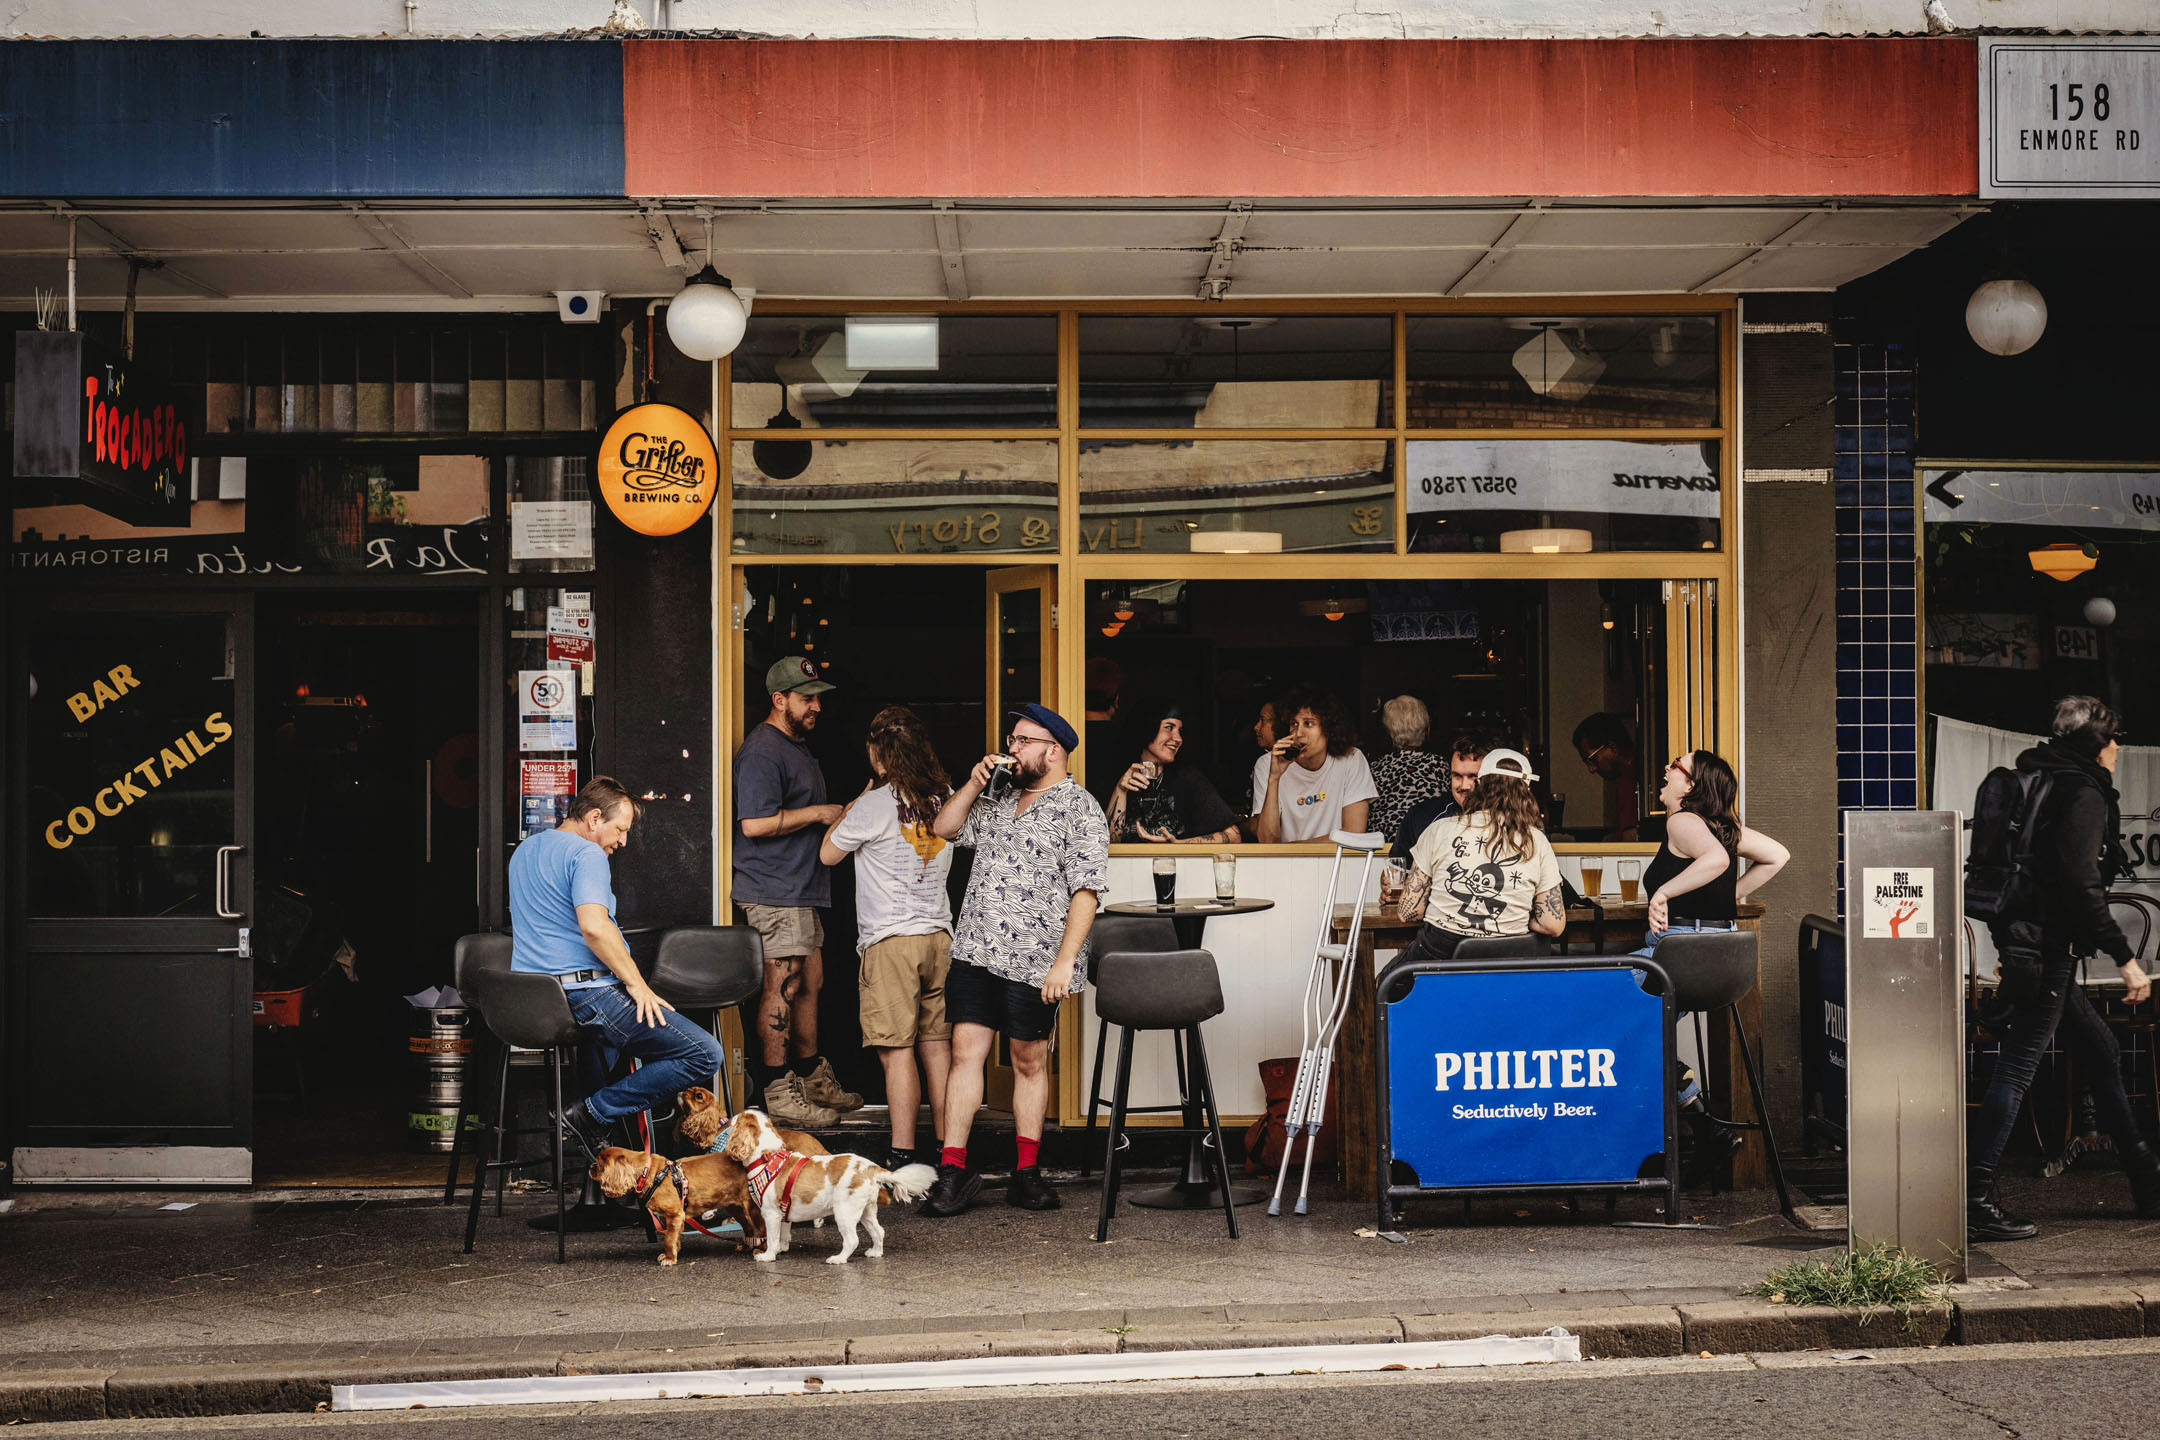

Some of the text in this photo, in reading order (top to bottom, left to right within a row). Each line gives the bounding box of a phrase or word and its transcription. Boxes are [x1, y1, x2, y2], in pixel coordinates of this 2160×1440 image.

[2049, 82, 2110, 122] 158
[2020, 128, 2140, 151] ENMORE RD
[85, 376, 186, 475] TROCADERO
[650, 435, 668, 444] THE
[619, 432, 705, 486] Grifter
[624, 493, 702, 503] BREWING CO.
[66, 664, 141, 724] BAR
[537, 682, 559, 697] 50
[525, 764, 572, 772] UNDER 25?
[45, 711, 233, 850] COCKTAILS
[1893, 872, 1909, 885] FREE
[1876, 885, 1924, 898] PALESTINE
[1824, 1000, 1847, 1043] PHIL
[1434, 1048, 1618, 1092] PHILTER
[1452, 1102, 1597, 1121] Seductively Beer.
